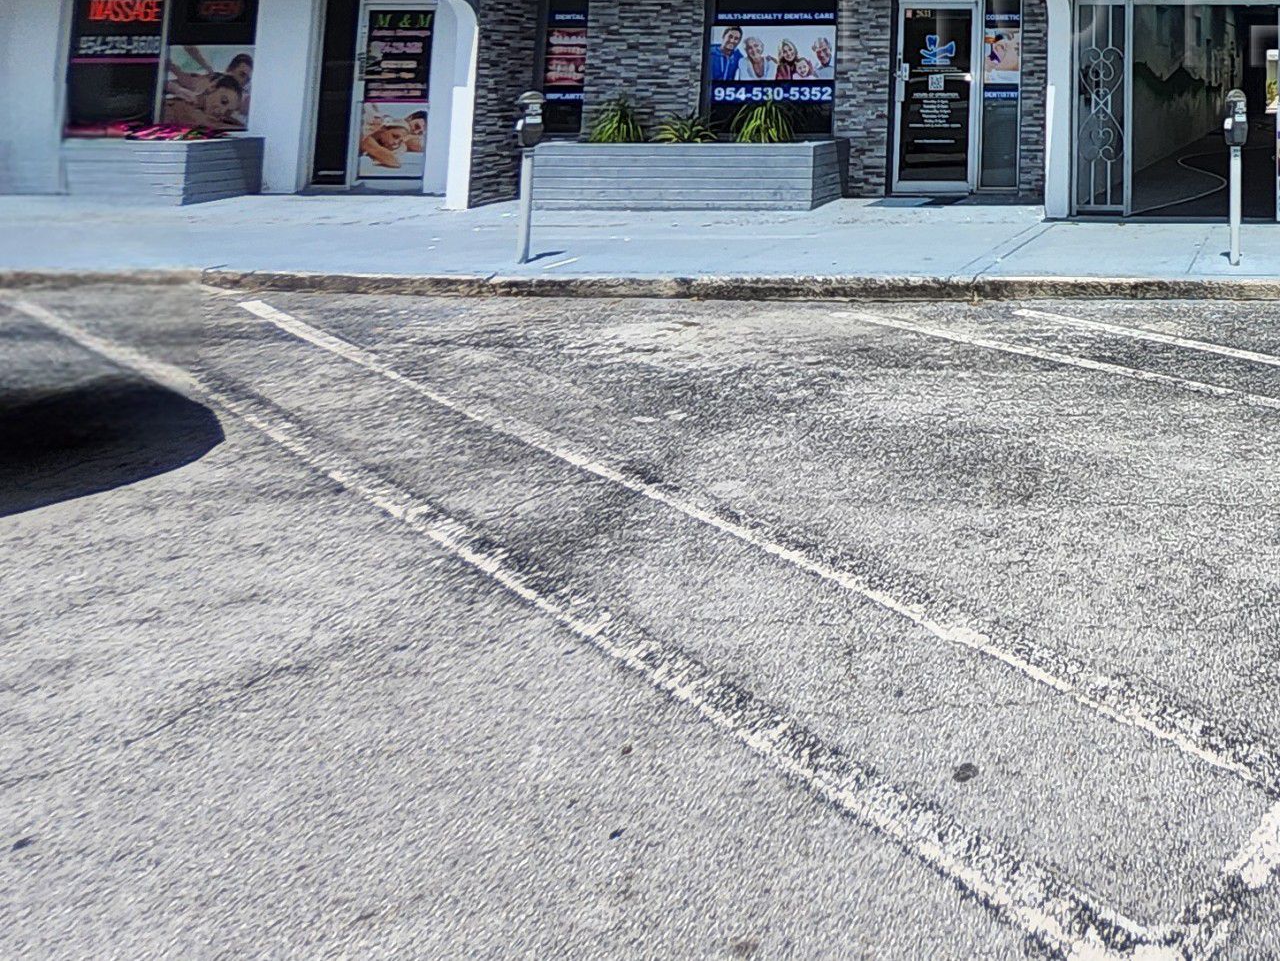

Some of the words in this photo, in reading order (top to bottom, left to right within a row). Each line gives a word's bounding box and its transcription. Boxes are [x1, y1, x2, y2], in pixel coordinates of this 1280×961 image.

[376, 14, 392, 27] M
[416, 14, 432, 27] M
[714, 87, 832, 101] 954-530-5352
